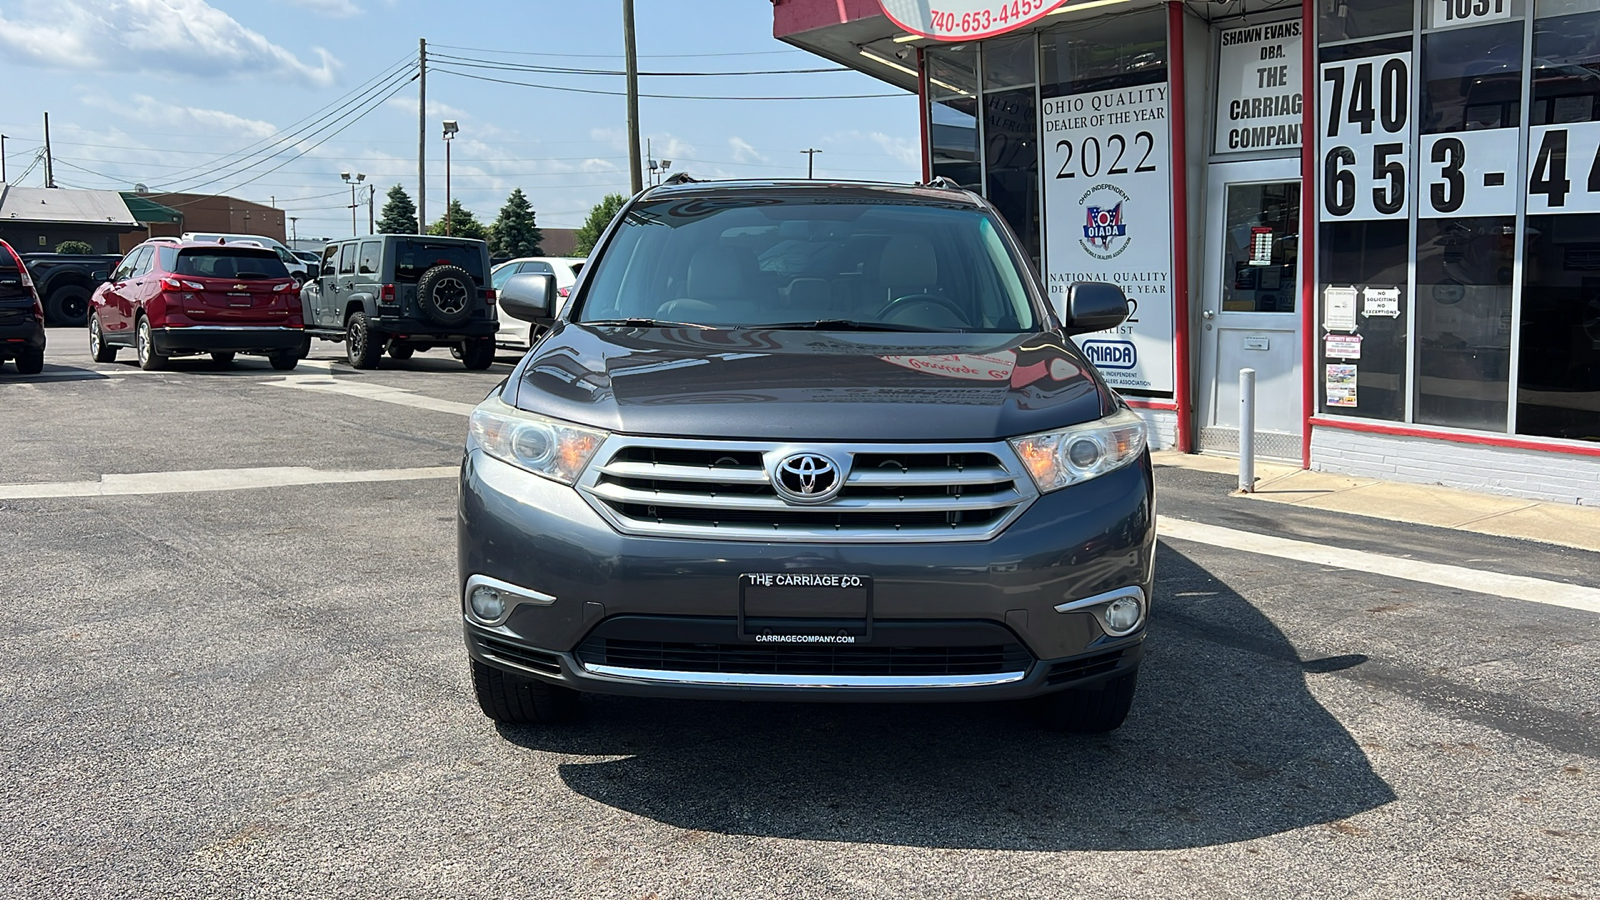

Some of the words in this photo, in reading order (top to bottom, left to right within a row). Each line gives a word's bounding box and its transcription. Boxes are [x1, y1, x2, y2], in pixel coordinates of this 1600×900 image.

[1223, 27, 1261, 46] SHAWN
[1264, 22, 1302, 40] EVANS.
[1260, 44, 1285, 60] DBA.
[1257, 65, 1287, 88] THE
[1044, 98, 1084, 115] OHIO
[1091, 87, 1166, 111] QUALITY
[1229, 93, 1302, 120] CARRIAG
[1324, 58, 1408, 137] 740
[1046, 116, 1087, 132] DEALER
[1090, 114, 1105, 127] OF
[1107, 111, 1130, 125] THE
[1133, 107, 1165, 121] YEAR
[1228, 123, 1303, 149] COMPAN
[1055, 131, 1156, 179] 2022
[1078, 189, 1091, 205] OHIO
[1091, 183, 1130, 202] INDEPENDENT
[1088, 226, 1119, 237] OIADA
[1050, 272, 1108, 282] NATIONAL
[1113, 272, 1167, 283] QUALITY
[1137, 285, 1166, 294] YEAR
[1086, 346, 1131, 362] NIADA
[748, 574, 773, 586] THE
[776, 575, 839, 586] CARRIAGE
[841, 575, 862, 587] CO.
[755, 635, 855, 643] CARRIAGECOMPANY.COM
